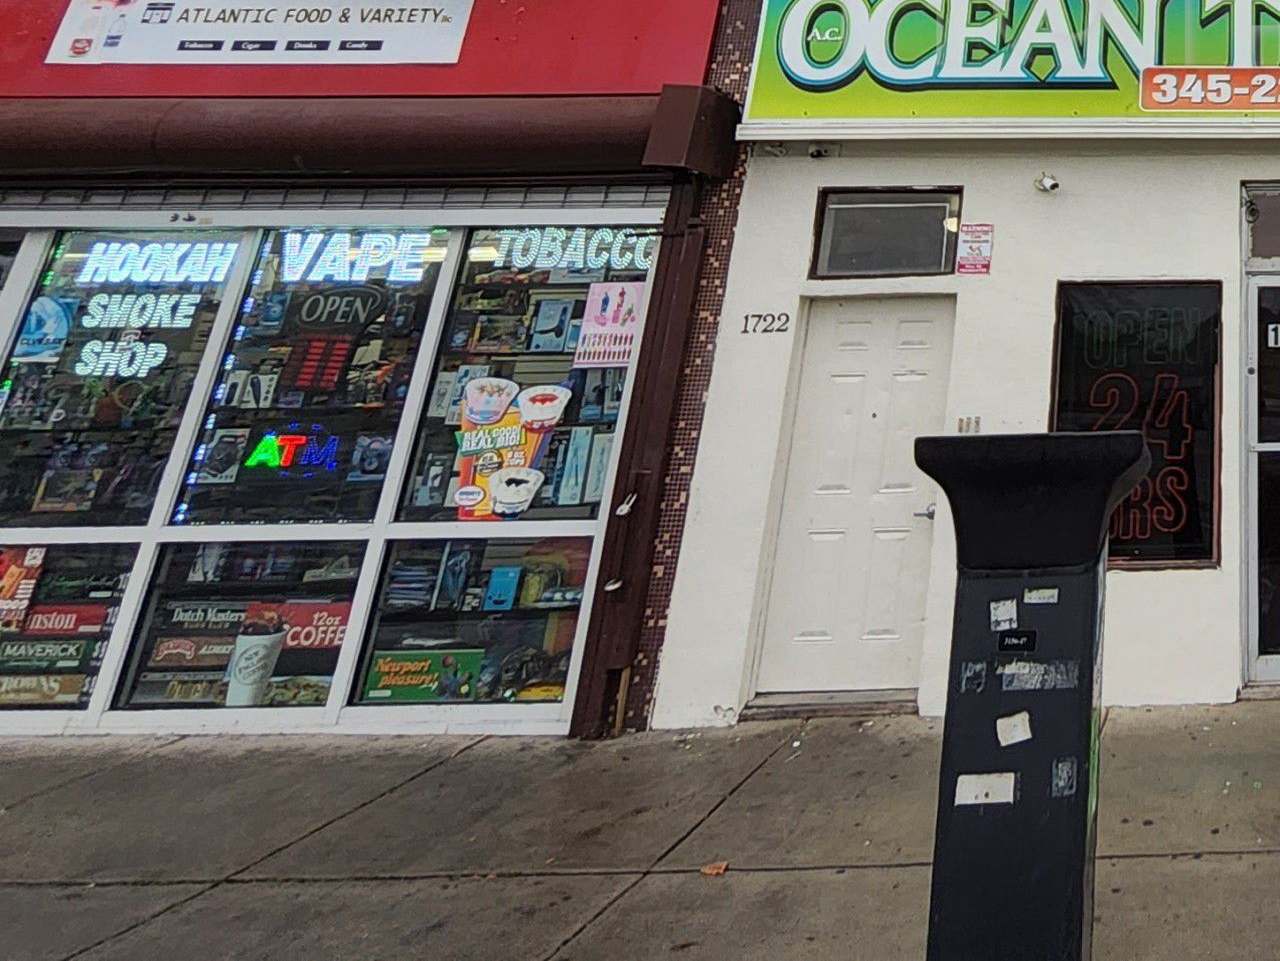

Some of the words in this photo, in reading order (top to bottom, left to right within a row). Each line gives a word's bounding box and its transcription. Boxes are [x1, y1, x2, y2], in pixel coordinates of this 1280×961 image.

[176, 8, 278, 24] ATLANTIC
[284, 8, 332, 24] FOOD
[338, 8, 351, 24] &
[360, 8, 443, 24] VARIETY
[77, 241, 239, 283] HOOKAH
[280, 231, 432, 282] VAPE
[82, 293, 202, 329] SMOKE
[301, 293, 376, 325] OPEN
[741, 312, 791, 334] 1722
[1083, 304, 1201, 370] OPEN
[75, 339, 168, 378] SHOP
[1090, 373, 1193, 460] 24
[244, 435, 339, 469] ATM
[171, 607, 204, 623] Dutch
[312, 611, 343, 626] 12oz
[3, 643, 79, 657] MAVERICK
[375, 656, 431, 674] Newport
[378, 670, 438, 688] pleasure!
